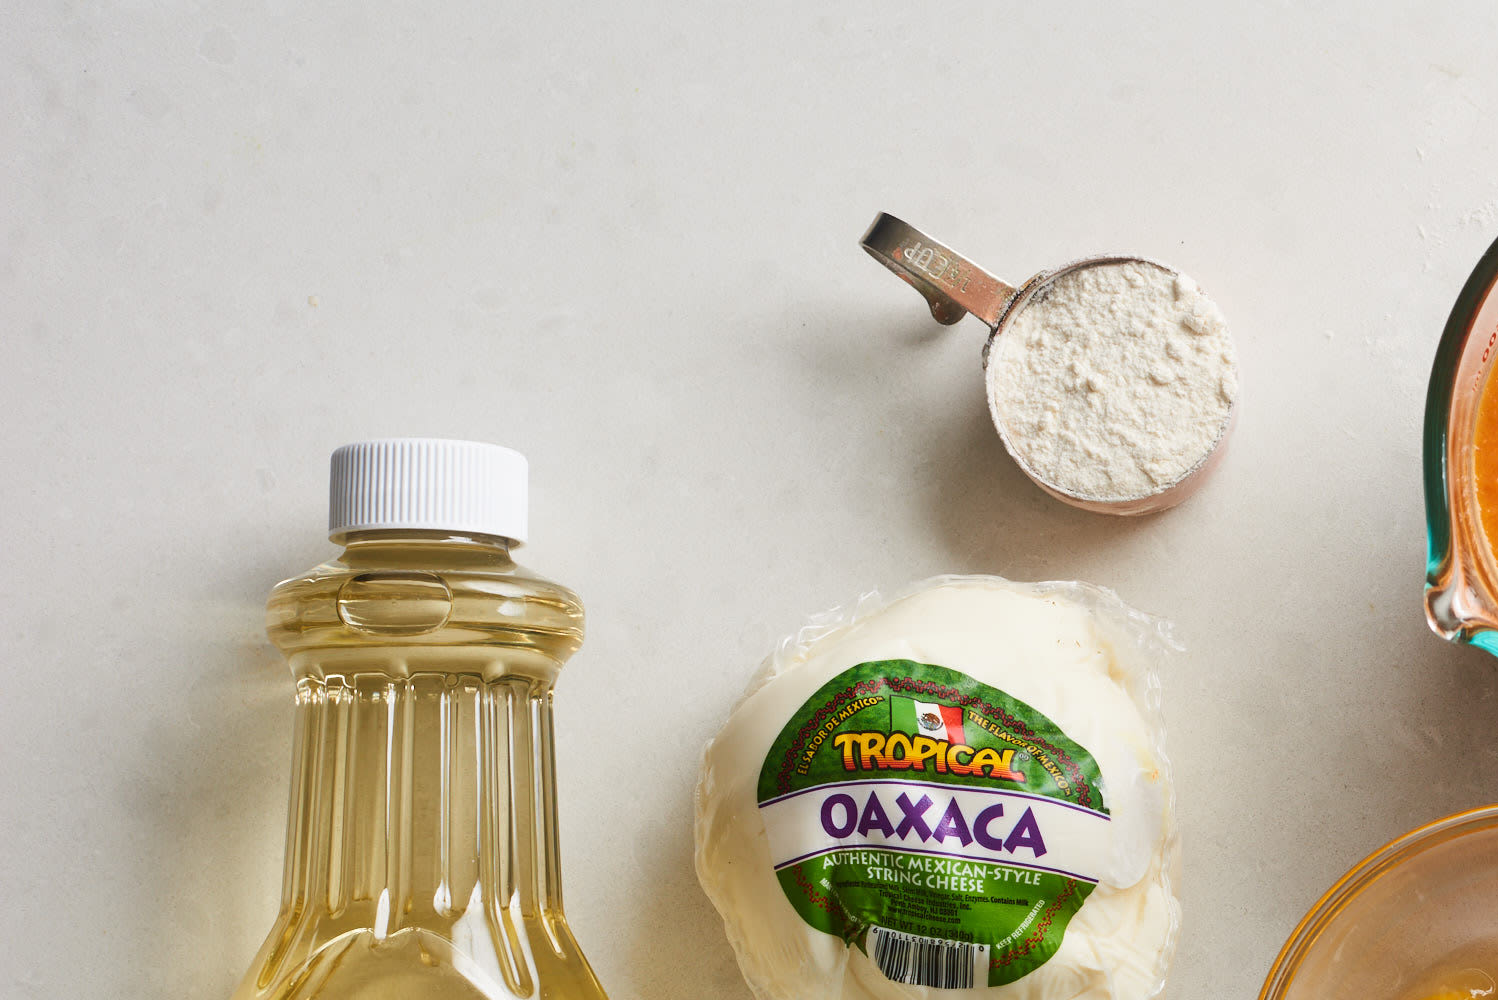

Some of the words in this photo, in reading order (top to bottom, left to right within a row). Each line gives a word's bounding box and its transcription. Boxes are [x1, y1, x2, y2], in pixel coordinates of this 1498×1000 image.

[903, 241, 950, 280] CUP
[824, 716, 841, 732] DE
[968, 710, 989, 729] THE
[988, 722, 1029, 748] FLAVOR
[1026, 744, 1042, 757] OF
[802, 729, 829, 763] SABOR
[832, 730, 1027, 783] TROPICAL
[797, 763, 809, 775] EL
[820, 789, 1047, 858] OAXACA
[822, 852, 904, 870] AUTHENTIC
[908, 856, 1043, 886] MEXICAN-STYLE
[867, 866, 922, 887] STRING
[925, 875, 985, 893] CHEESE
[880, 889, 902, 901] Tropical
[881, 915, 897, 927] NET
[900, 920, 913, 931] WT
[916, 923, 927, 933] 12
[929, 926, 942, 938] OZ
[995, 936, 1012, 950] KEEP
[1011, 899, 1046, 940] REFRIGERATED
